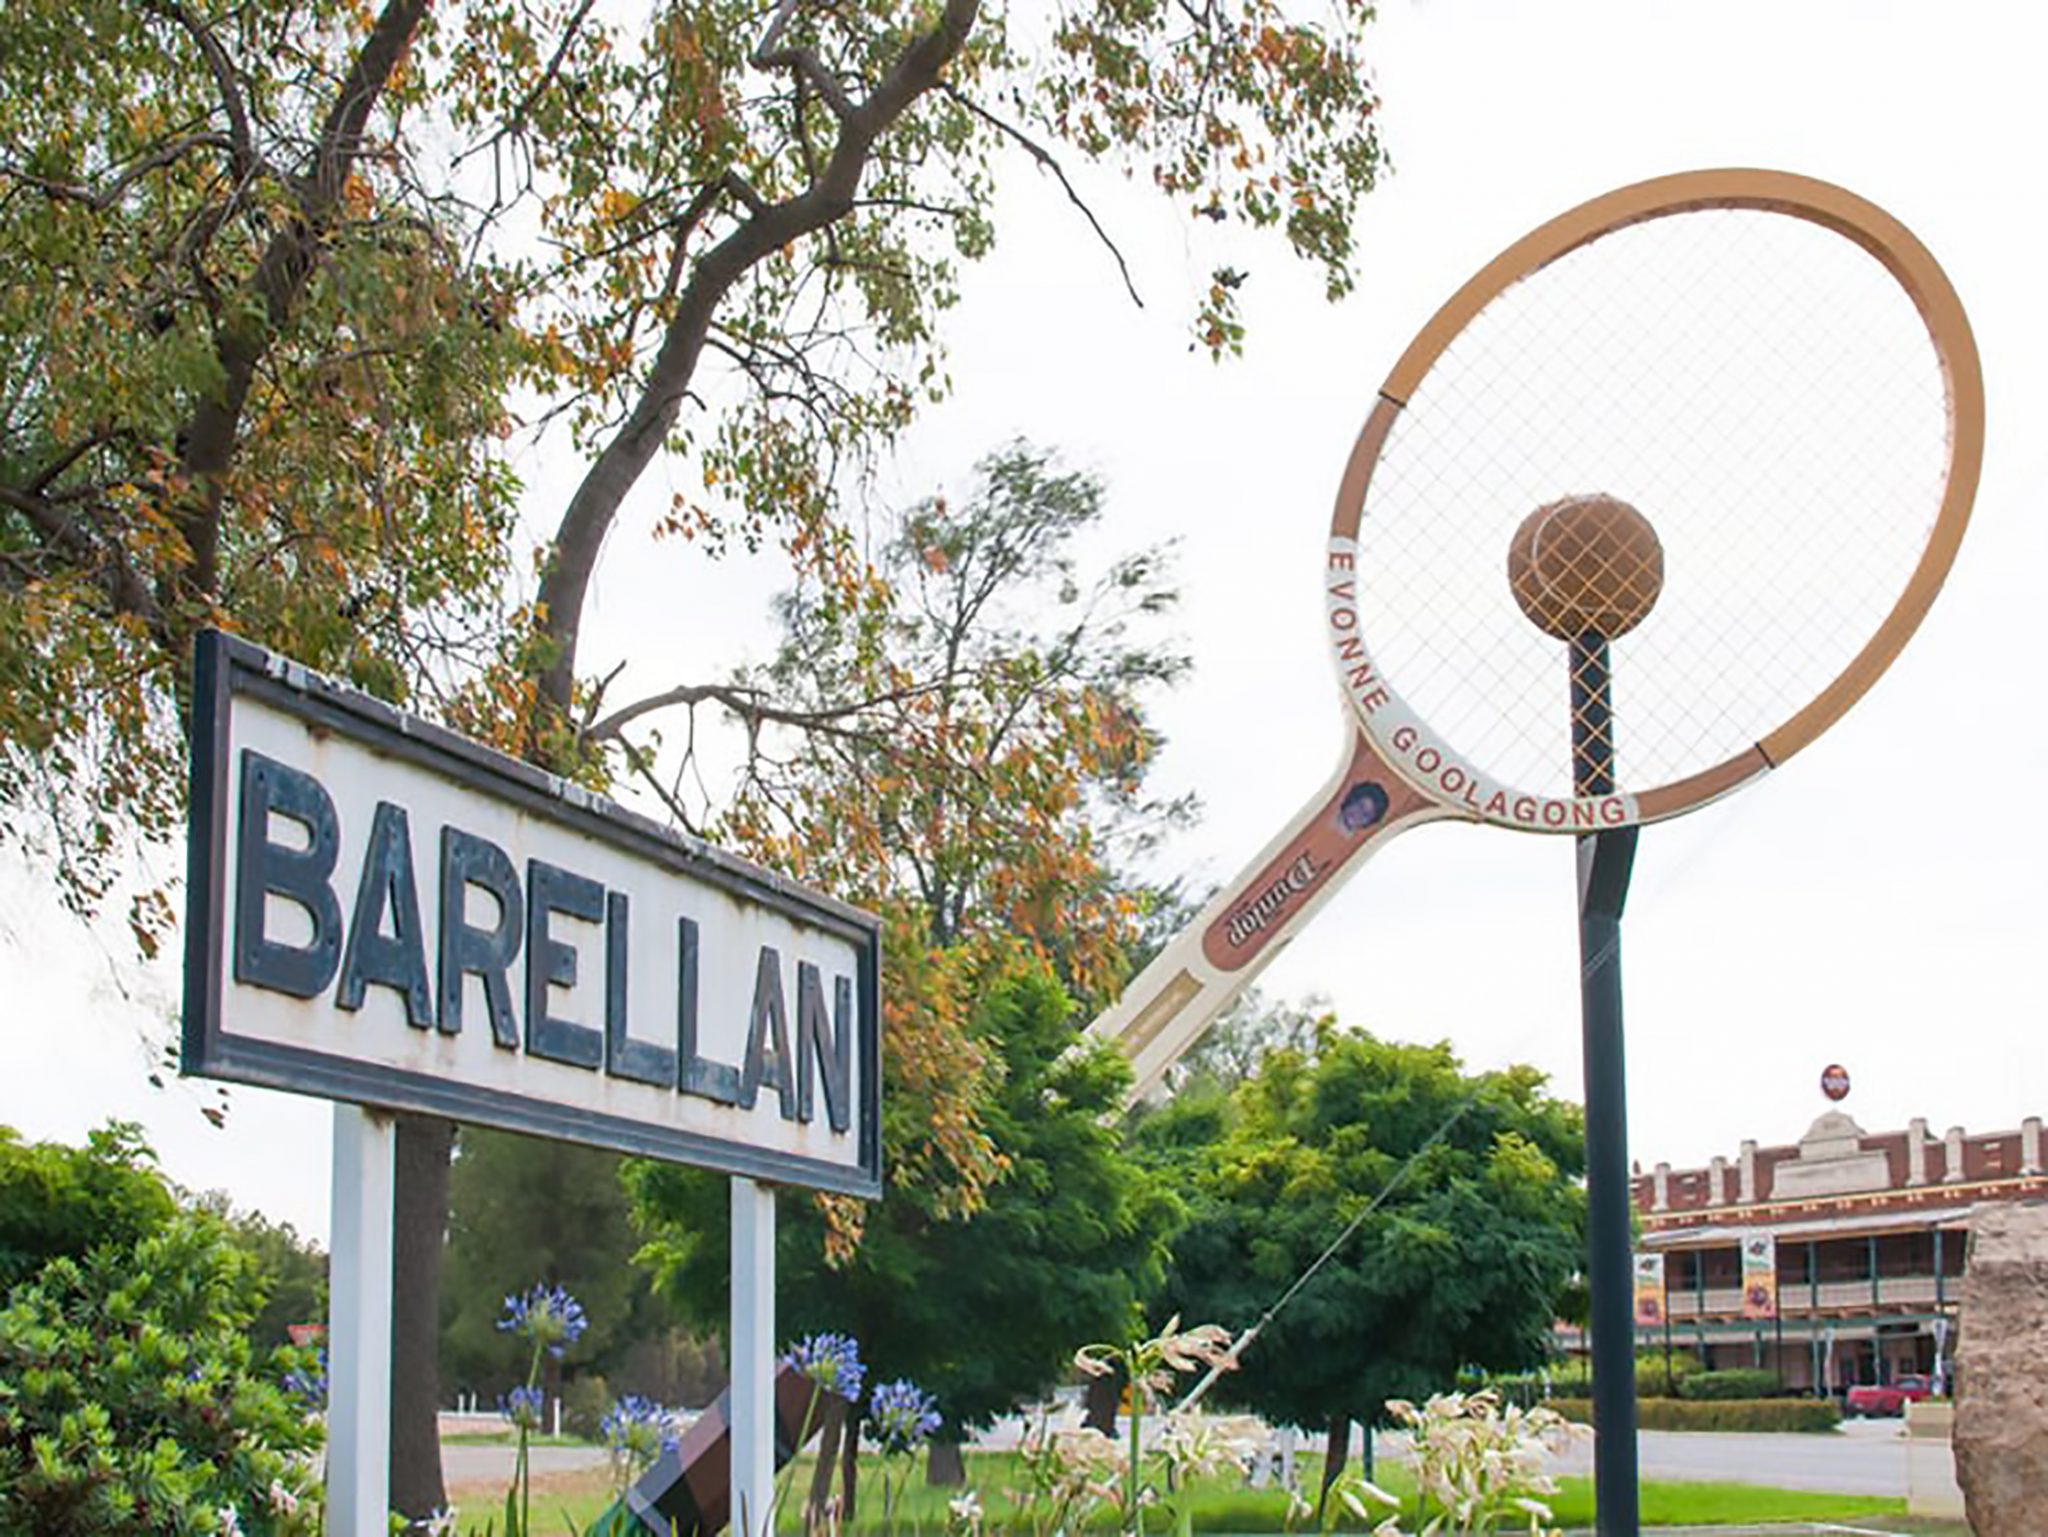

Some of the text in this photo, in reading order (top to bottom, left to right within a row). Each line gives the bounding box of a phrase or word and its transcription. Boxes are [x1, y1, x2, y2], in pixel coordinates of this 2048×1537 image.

[1328, 551, 1625, 825] EVONNE GOOLAGONG
[235, 749, 852, 1133] BARELLAN
[1227, 851, 1322, 947] Dunlop
